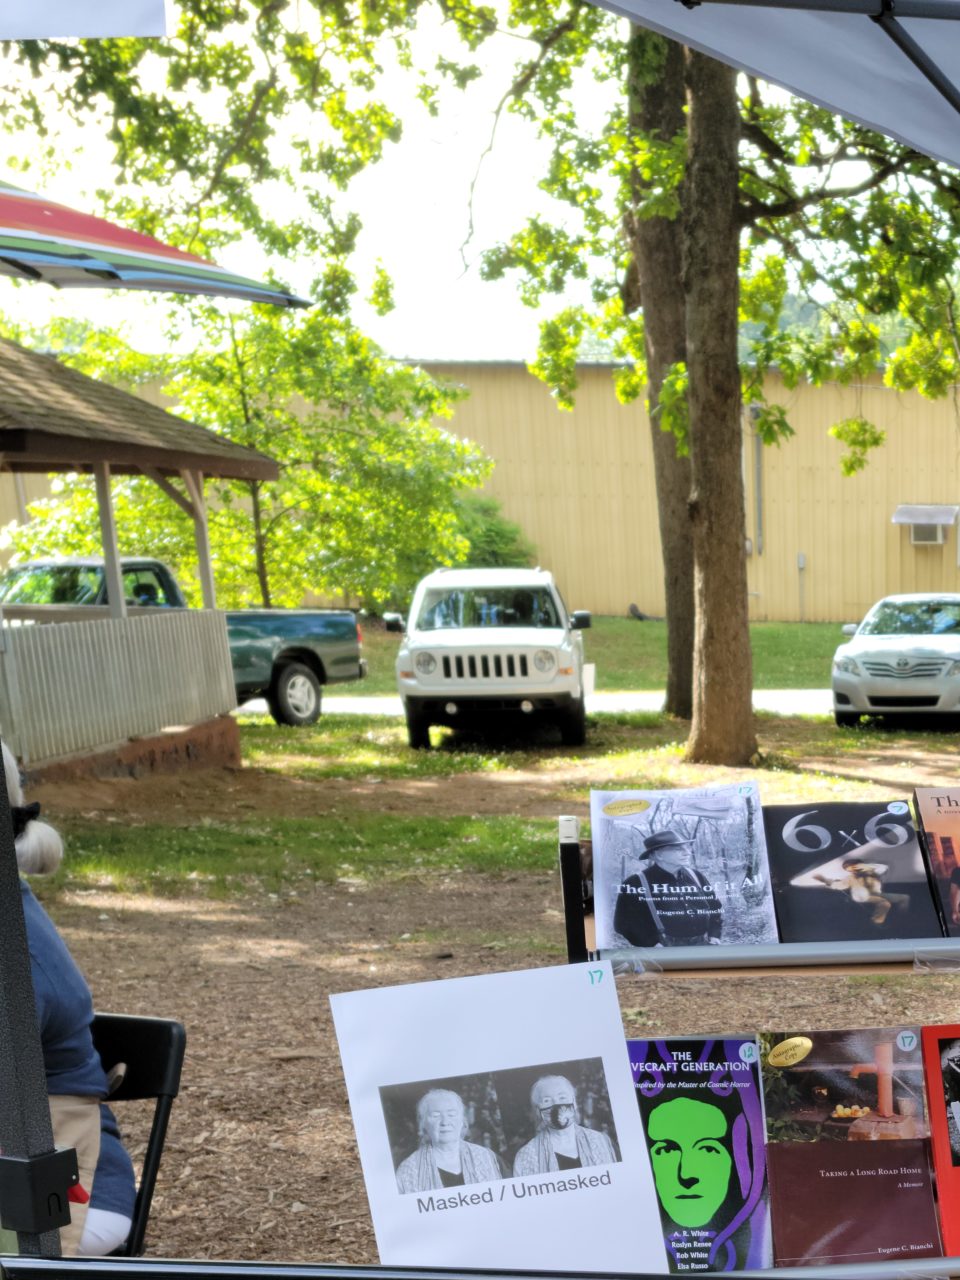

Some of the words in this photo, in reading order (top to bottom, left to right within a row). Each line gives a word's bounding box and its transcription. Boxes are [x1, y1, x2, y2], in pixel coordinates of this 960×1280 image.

[614, 883, 647, 894] The
[652, 883, 698, 894] Hum
[702, 881, 720, 892] of
[742, 874, 764, 888] All
[656, 909, 685, 917] Eugene
[588, 969, 604, 985] 17
[901, 1035, 914, 1048] 17
[671, 1051, 692, 1061] THE
[681, 1062, 750, 1071] GENERATION
[416, 1187, 494, 1214] Masked
[511, 1170, 612, 1199] Unmasked
[910, 1243, 934, 1251] Bianchi
